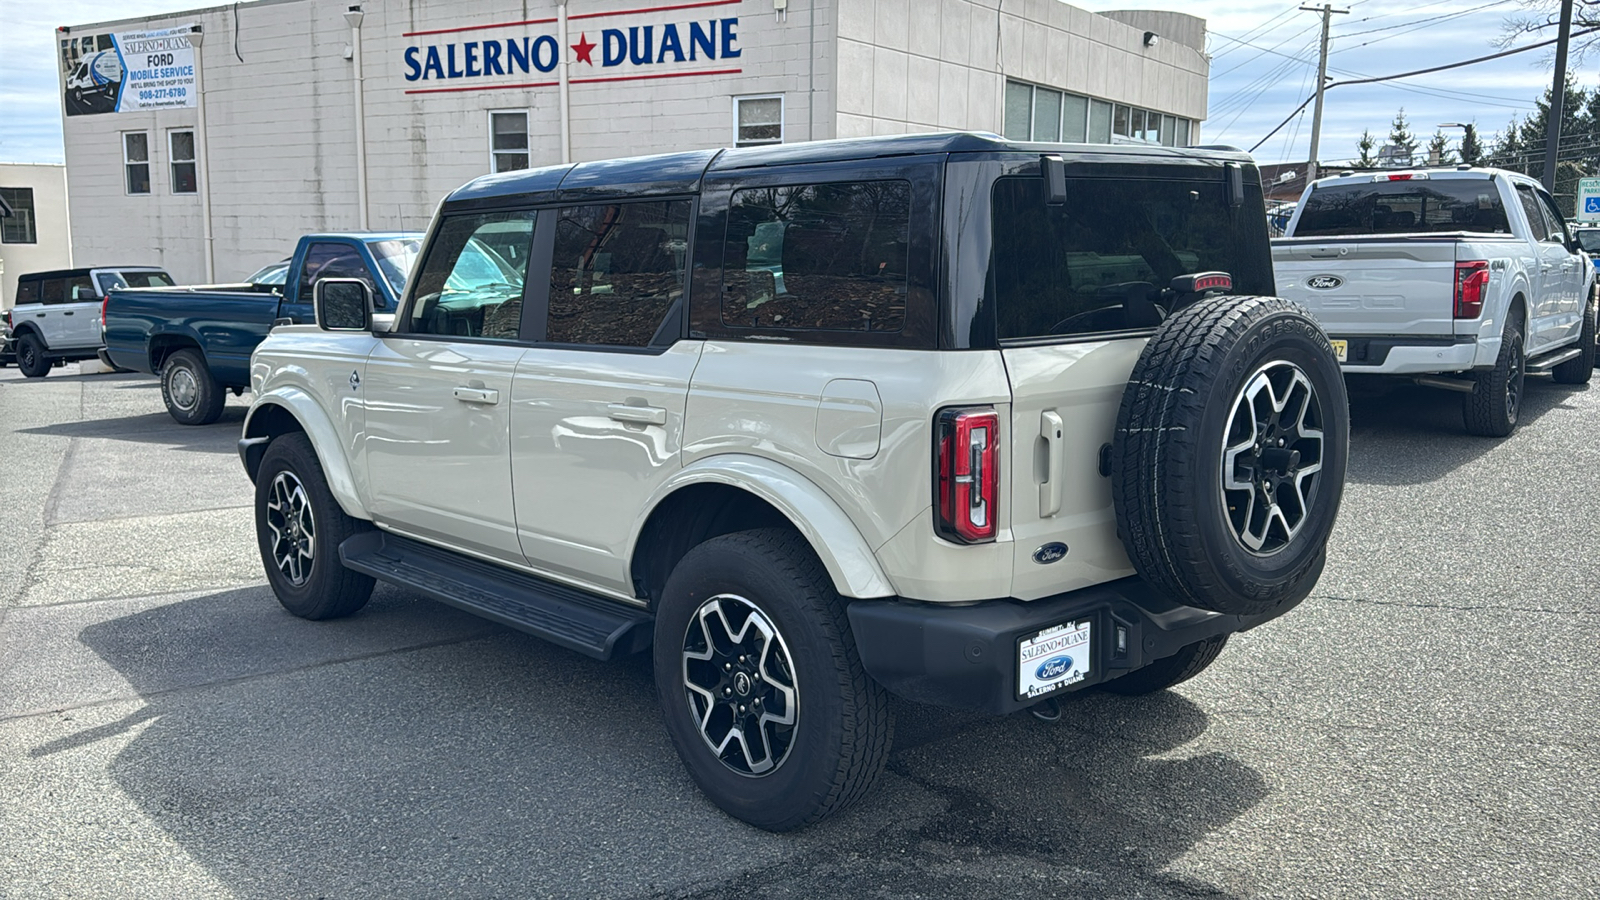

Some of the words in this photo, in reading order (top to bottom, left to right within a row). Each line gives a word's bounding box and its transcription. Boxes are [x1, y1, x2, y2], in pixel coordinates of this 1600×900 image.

[124, 40, 158, 54] SALERNO
[163, 37, 190, 49] DUANE
[404, 34, 559, 82] SALERNO
[601, 17, 742, 68] DUANE
[147, 53, 174, 67] FORD
[130, 68, 160, 81] MOBILE
[160, 65, 193, 79] SERVICE
[139, 87, 186, 100] 908-277-6780
[1312, 277, 1337, 289] Ford
[1042, 547, 1063, 561] Ford
[1022, 640, 1058, 661] SALERNO
[1061, 630, 1088, 647] DUANE
[1042, 659, 1067, 678] Ford
[1027, 683, 1056, 699] SALERNO
[1064, 673, 1085, 687] DUANE
